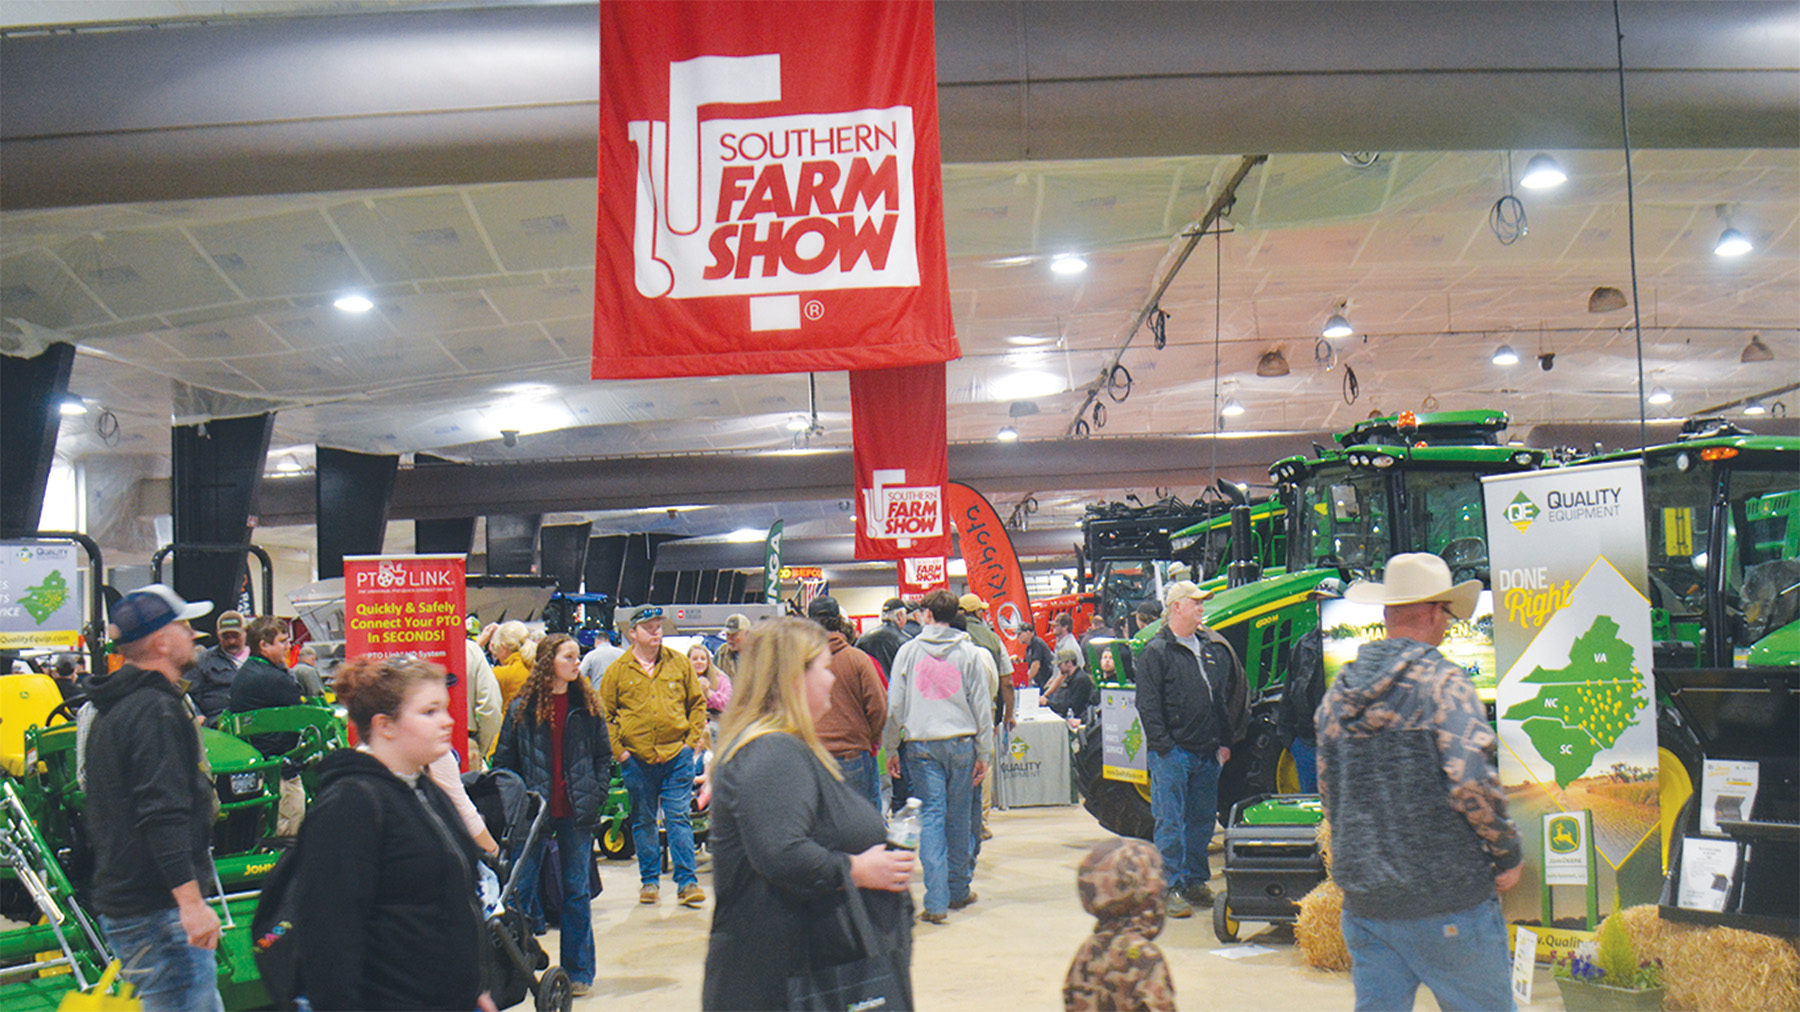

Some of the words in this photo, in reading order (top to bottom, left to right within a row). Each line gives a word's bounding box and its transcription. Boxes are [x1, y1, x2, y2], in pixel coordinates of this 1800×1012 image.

[720, 120, 897, 161] SOUTHERN
[716, 155, 899, 223] FARM
[702, 214, 899, 280] SHOW
[888, 490, 937, 501] SOUTHERN
[1547, 487, 1621, 510] QUALITY
[888, 500, 937, 518] FARM
[1508, 502, 1534, 522] QE
[1548, 504, 1620, 522] EQUIPMENT
[885, 516, 937, 534] SHOW
[917, 564, 942, 573] FARM
[409, 570, 450, 586] LINK
[1500, 567, 1548, 591] DONE
[356, 602, 402, 616] Quickly
[405, 602, 416, 614] &
[419, 601, 455, 614] Safely
[1504, 579, 1574, 628] Right
[351, 619, 401, 629] Connect
[404, 617, 434, 628] Your
[436, 615, 461, 627] PTO
[368, 633, 380, 643] In
[383, 630, 445, 643] SECONDS!
[419, 650, 446, 659] System
[1594, 653, 1607, 663] VA
[1544, 698, 1558, 708] NC
[1560, 745, 1573, 754] SC
